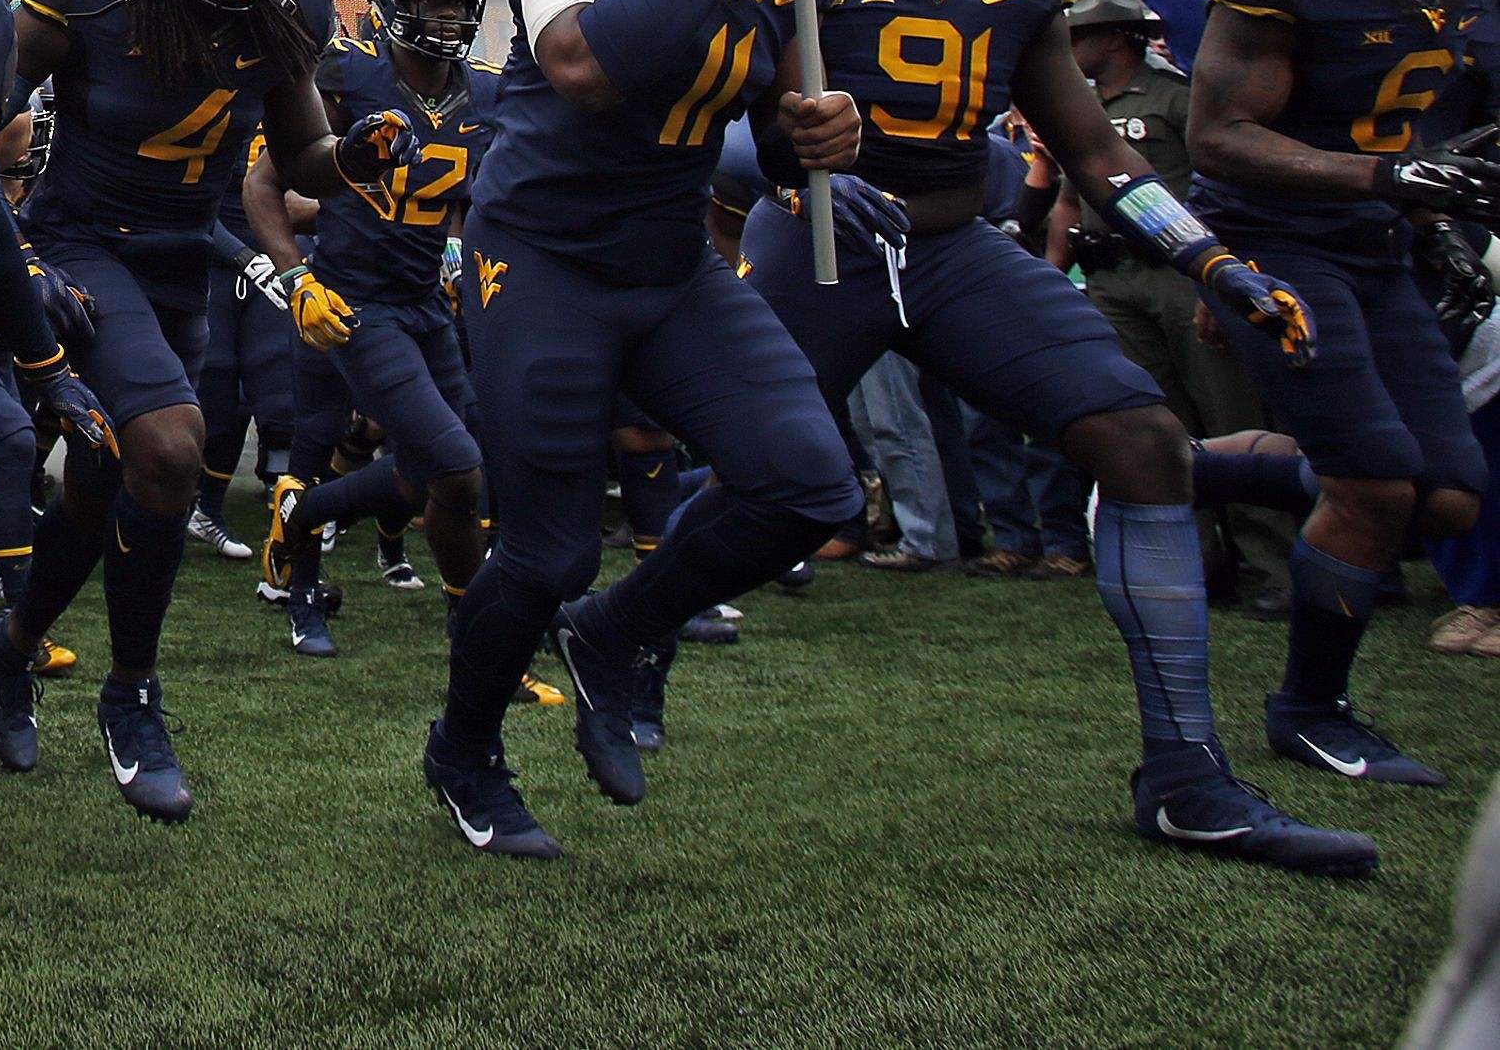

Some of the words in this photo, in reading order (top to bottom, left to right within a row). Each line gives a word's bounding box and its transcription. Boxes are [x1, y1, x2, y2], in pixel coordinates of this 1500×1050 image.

[659, 23, 756, 146] 11
[870, 17, 991, 140] 91
[1350, 49, 1454, 152] 6
[136, 89, 240, 185] 4
[392, 143, 468, 226] 12
